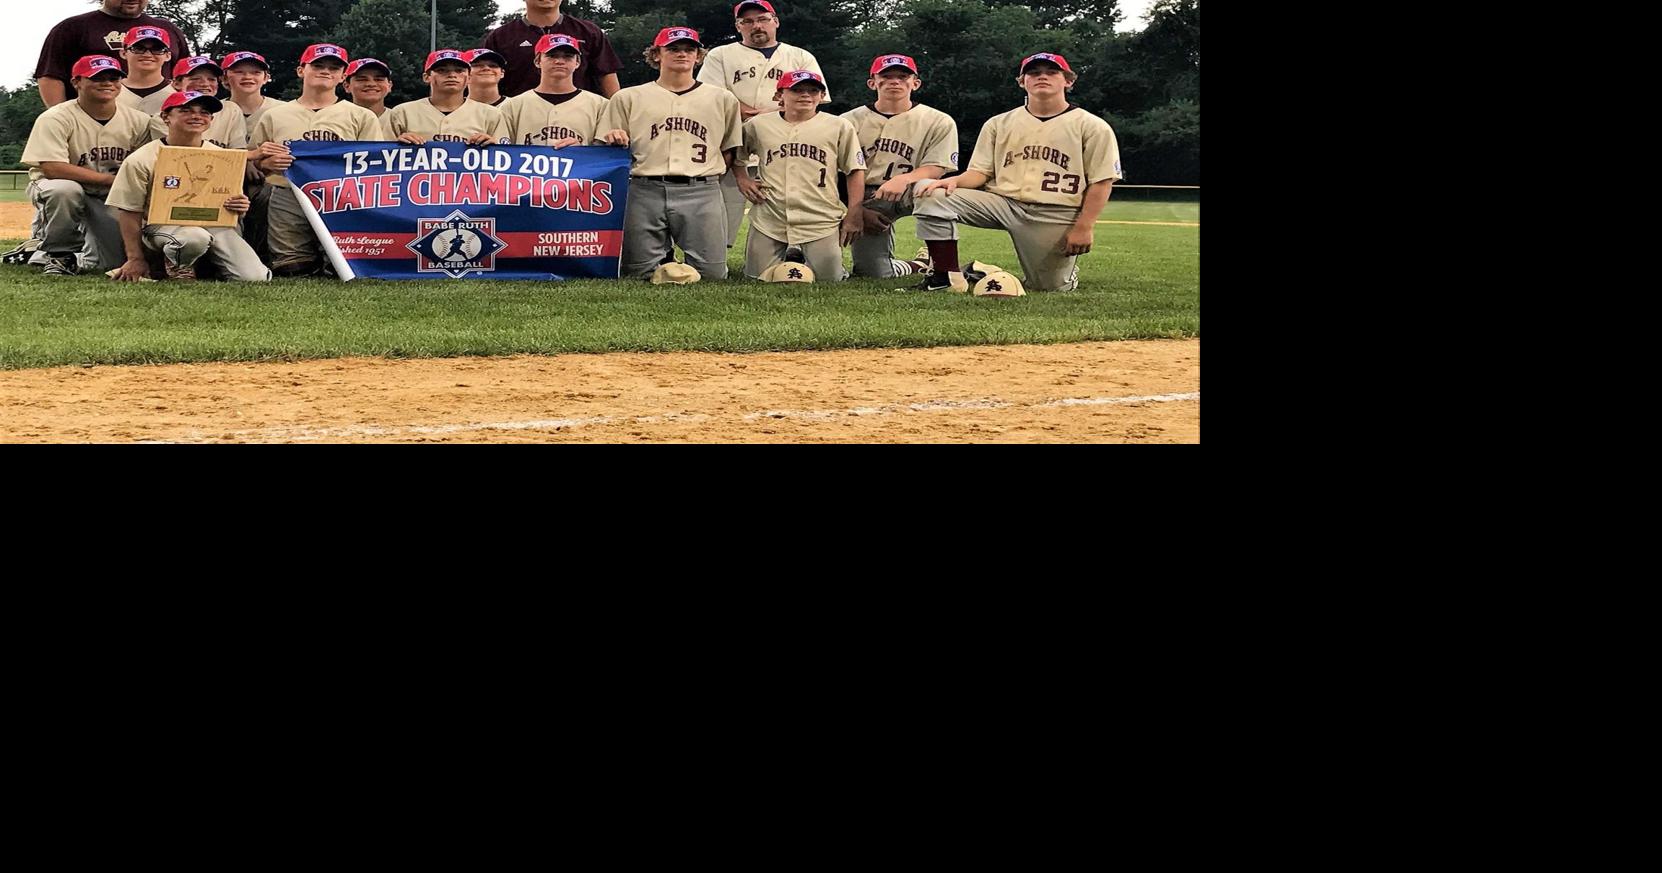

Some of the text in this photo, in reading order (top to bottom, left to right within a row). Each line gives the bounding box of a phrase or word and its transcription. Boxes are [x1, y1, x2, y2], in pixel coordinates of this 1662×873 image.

[650, 117, 707, 143] A-SHORE
[343, 148, 573, 178] 13-YEAR-OLD 2017
[691, 143, 707, 164] 3
[765, 142, 828, 166] A-SHORE
[1003, 145, 1070, 171] A-SHORE
[817, 168, 826, 188] 1
[1041, 171, 1081, 195] 23
[300, 172, 613, 215] STATE CHAMPIONS
[424, 222, 455, 230] BABE
[357, 236, 394, 248] League
[538, 232, 598, 244] SOUTHERN
[365, 248, 385, 256] 1951
[533, 244, 604, 256] NEW JERSEY
[428, 261, 484, 269] BASEBALL
